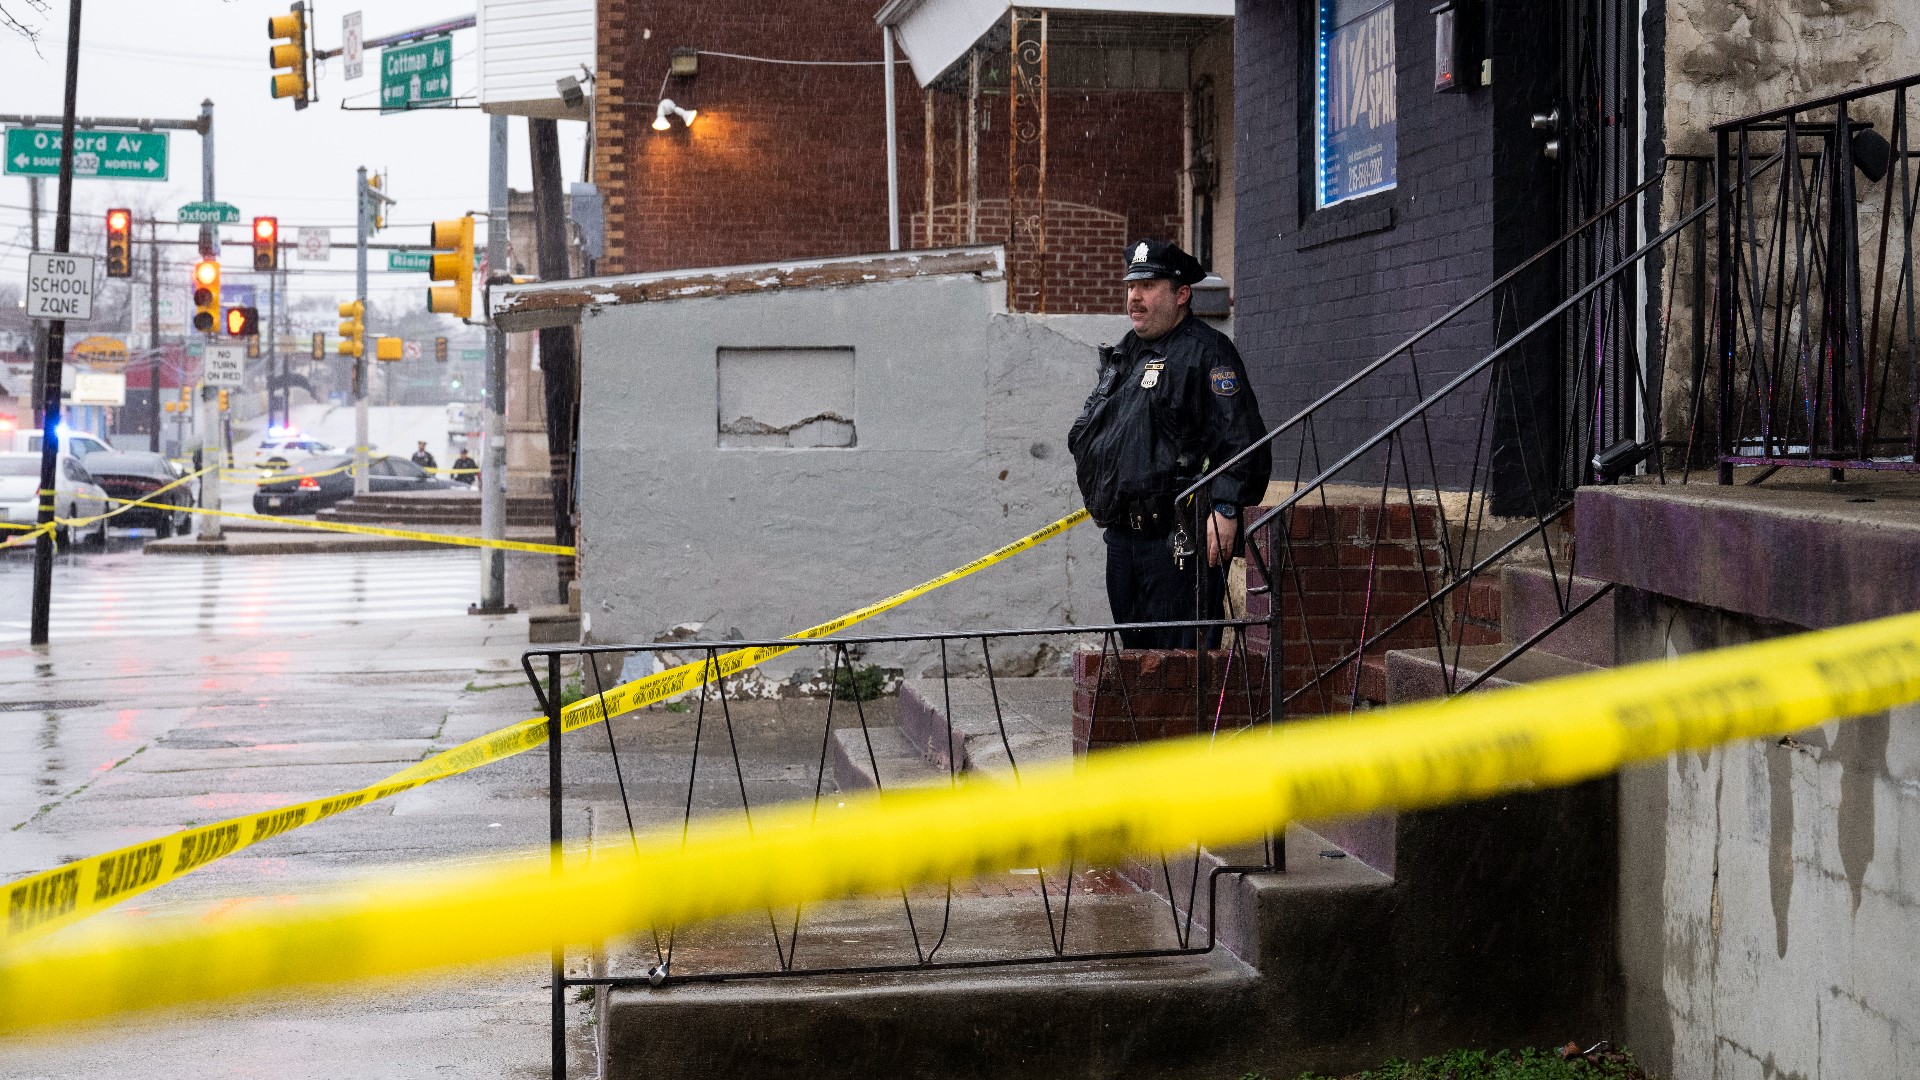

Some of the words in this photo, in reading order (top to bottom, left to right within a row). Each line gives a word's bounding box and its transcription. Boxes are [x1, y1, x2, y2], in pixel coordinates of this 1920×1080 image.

[1368, 6, 1395, 73] EVEN
[387, 53, 427, 76] Cottman
[432, 46, 445, 68] Av
[1368, 64, 1397, 130] SPAC
[34, 132, 107, 152] Oxord
[116, 136, 142, 153] Av
[33, 156, 62, 167] SOUT
[75, 157, 98, 170] 232
[104, 159, 141, 170] NORTH
[178, 209, 220, 222] Oxford
[225, 210, 240, 222] Av
[47, 259, 76, 275] END
[31, 277, 89, 295] SCHOOL
[40, 297, 79, 314] ZONE
[217, 351, 231, 359] NO
[212, 361, 237, 369] TURN
[207, 371, 220, 380] ON
[222, 371, 241, 380] RED
